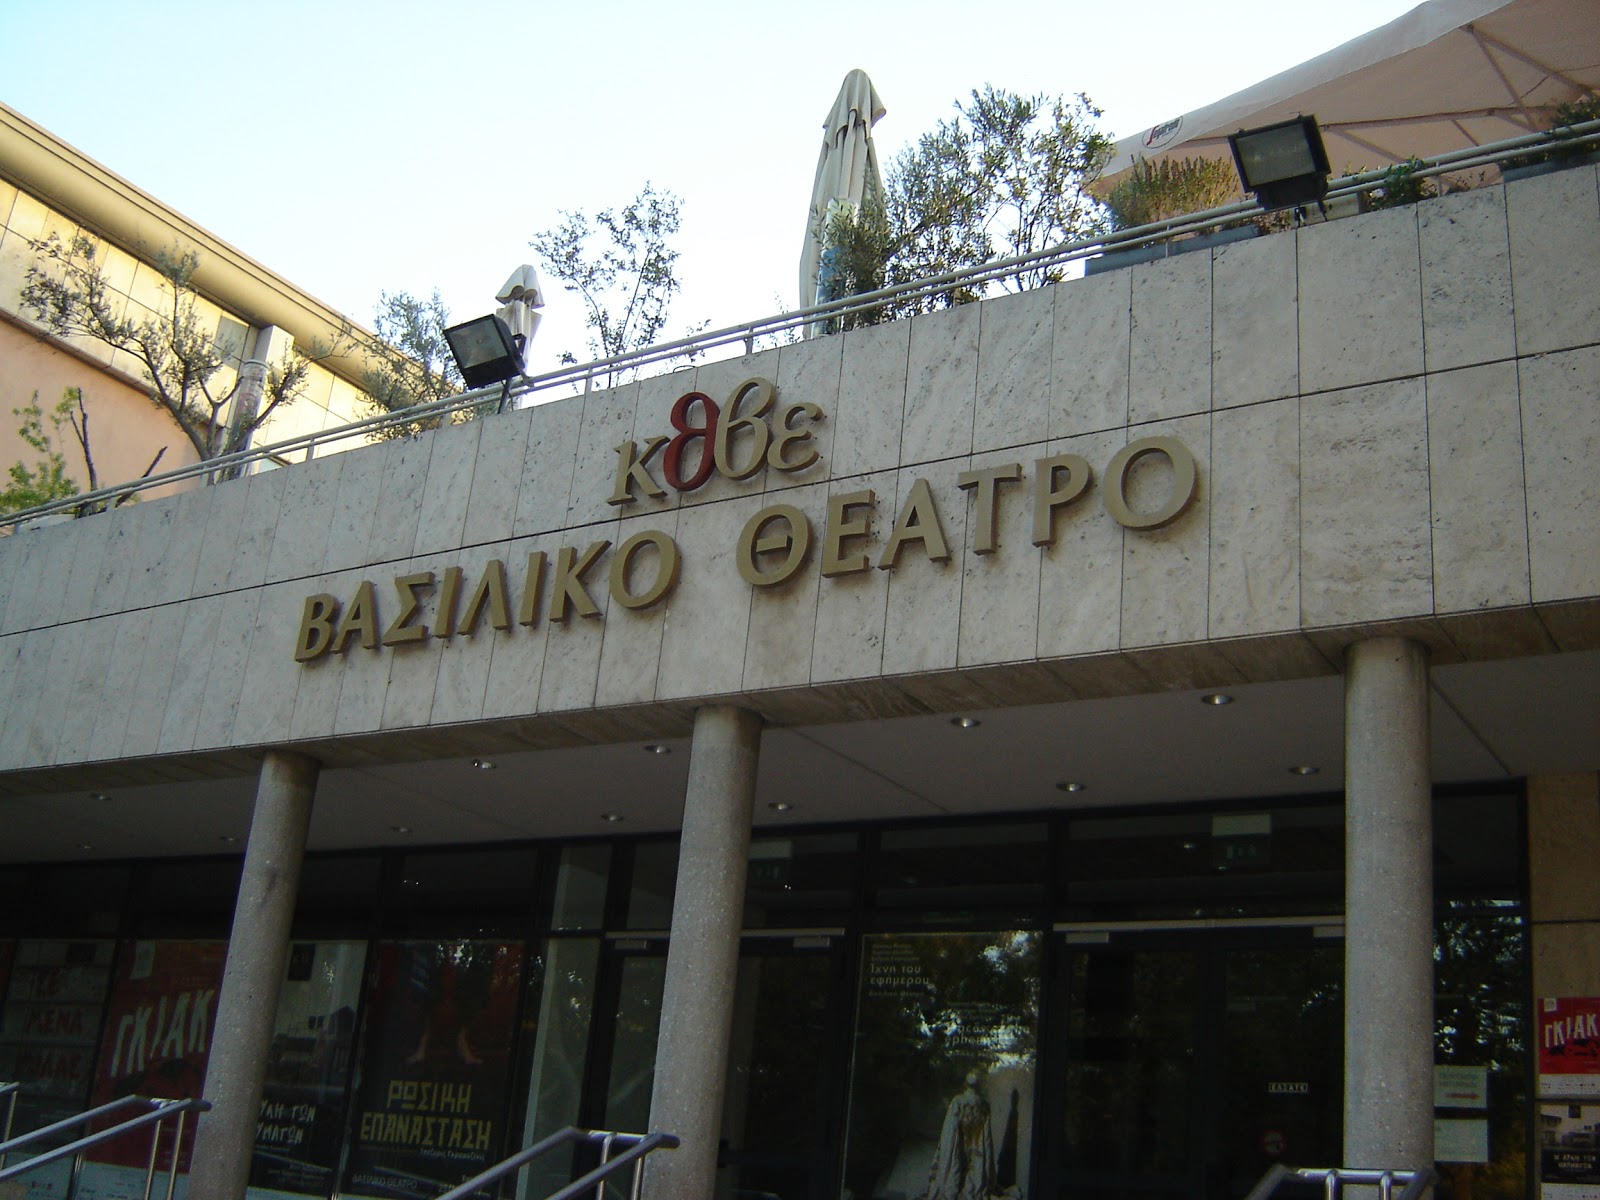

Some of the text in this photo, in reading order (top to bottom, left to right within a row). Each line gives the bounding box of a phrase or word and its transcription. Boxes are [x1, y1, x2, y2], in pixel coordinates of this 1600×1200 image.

[295, 436, 1198, 664] ΒΑΣΙΛΙΚΟ ΘΕΑΤΡΟ
[1544, 1013, 1599, 1048] ΓΚΙΑΚ
[387, 1080, 473, 1113] ΡΩΣΙΚΗ
[360, 1112, 492, 1150] ΕΠΑΝΑΣΤΑΣΗ
